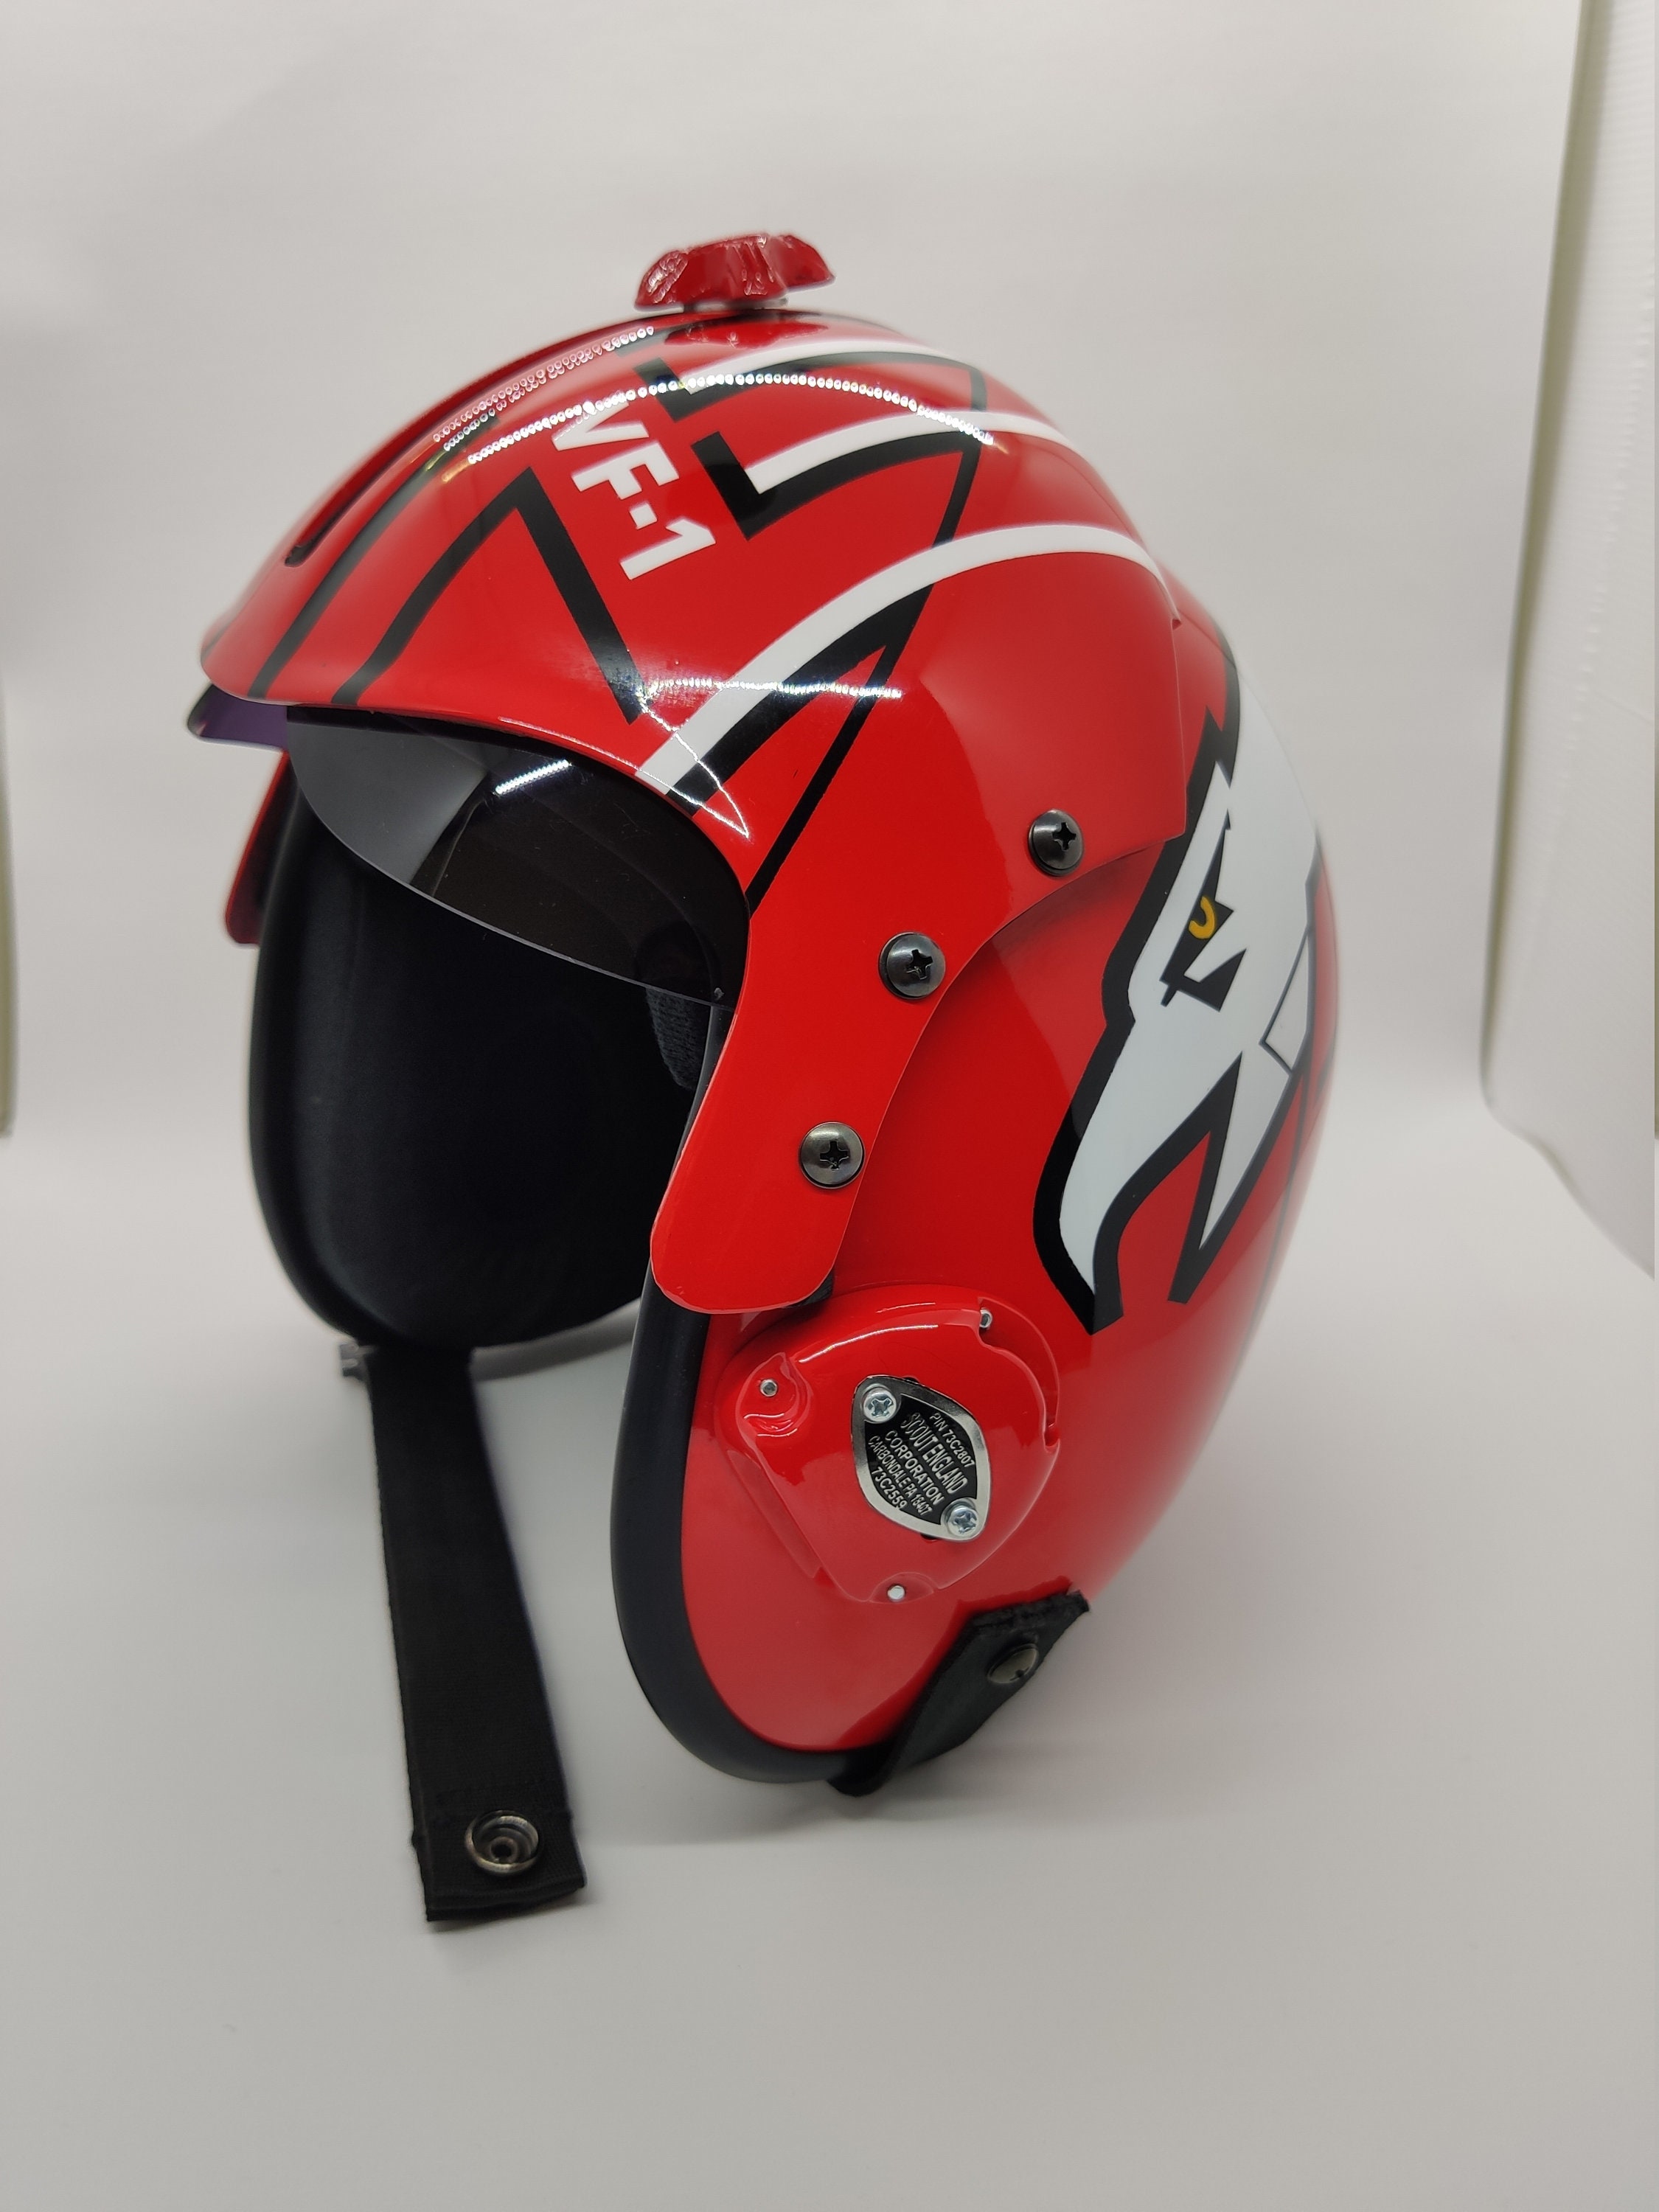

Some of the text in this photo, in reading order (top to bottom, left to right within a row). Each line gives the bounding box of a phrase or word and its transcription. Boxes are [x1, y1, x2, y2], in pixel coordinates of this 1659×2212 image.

[552, 397, 716, 580] VF-1
[868, 1436, 908, 1488] CARBONDALE
[905, 1484, 916, 1498] PA
[886, 1430, 945, 1505] CORPORATION
[901, 1413, 967, 1494] SCOUT ENGLAND
[942, 1430, 975, 1467] 73C2807
[872, 1467, 908, 1510] 73C2559
